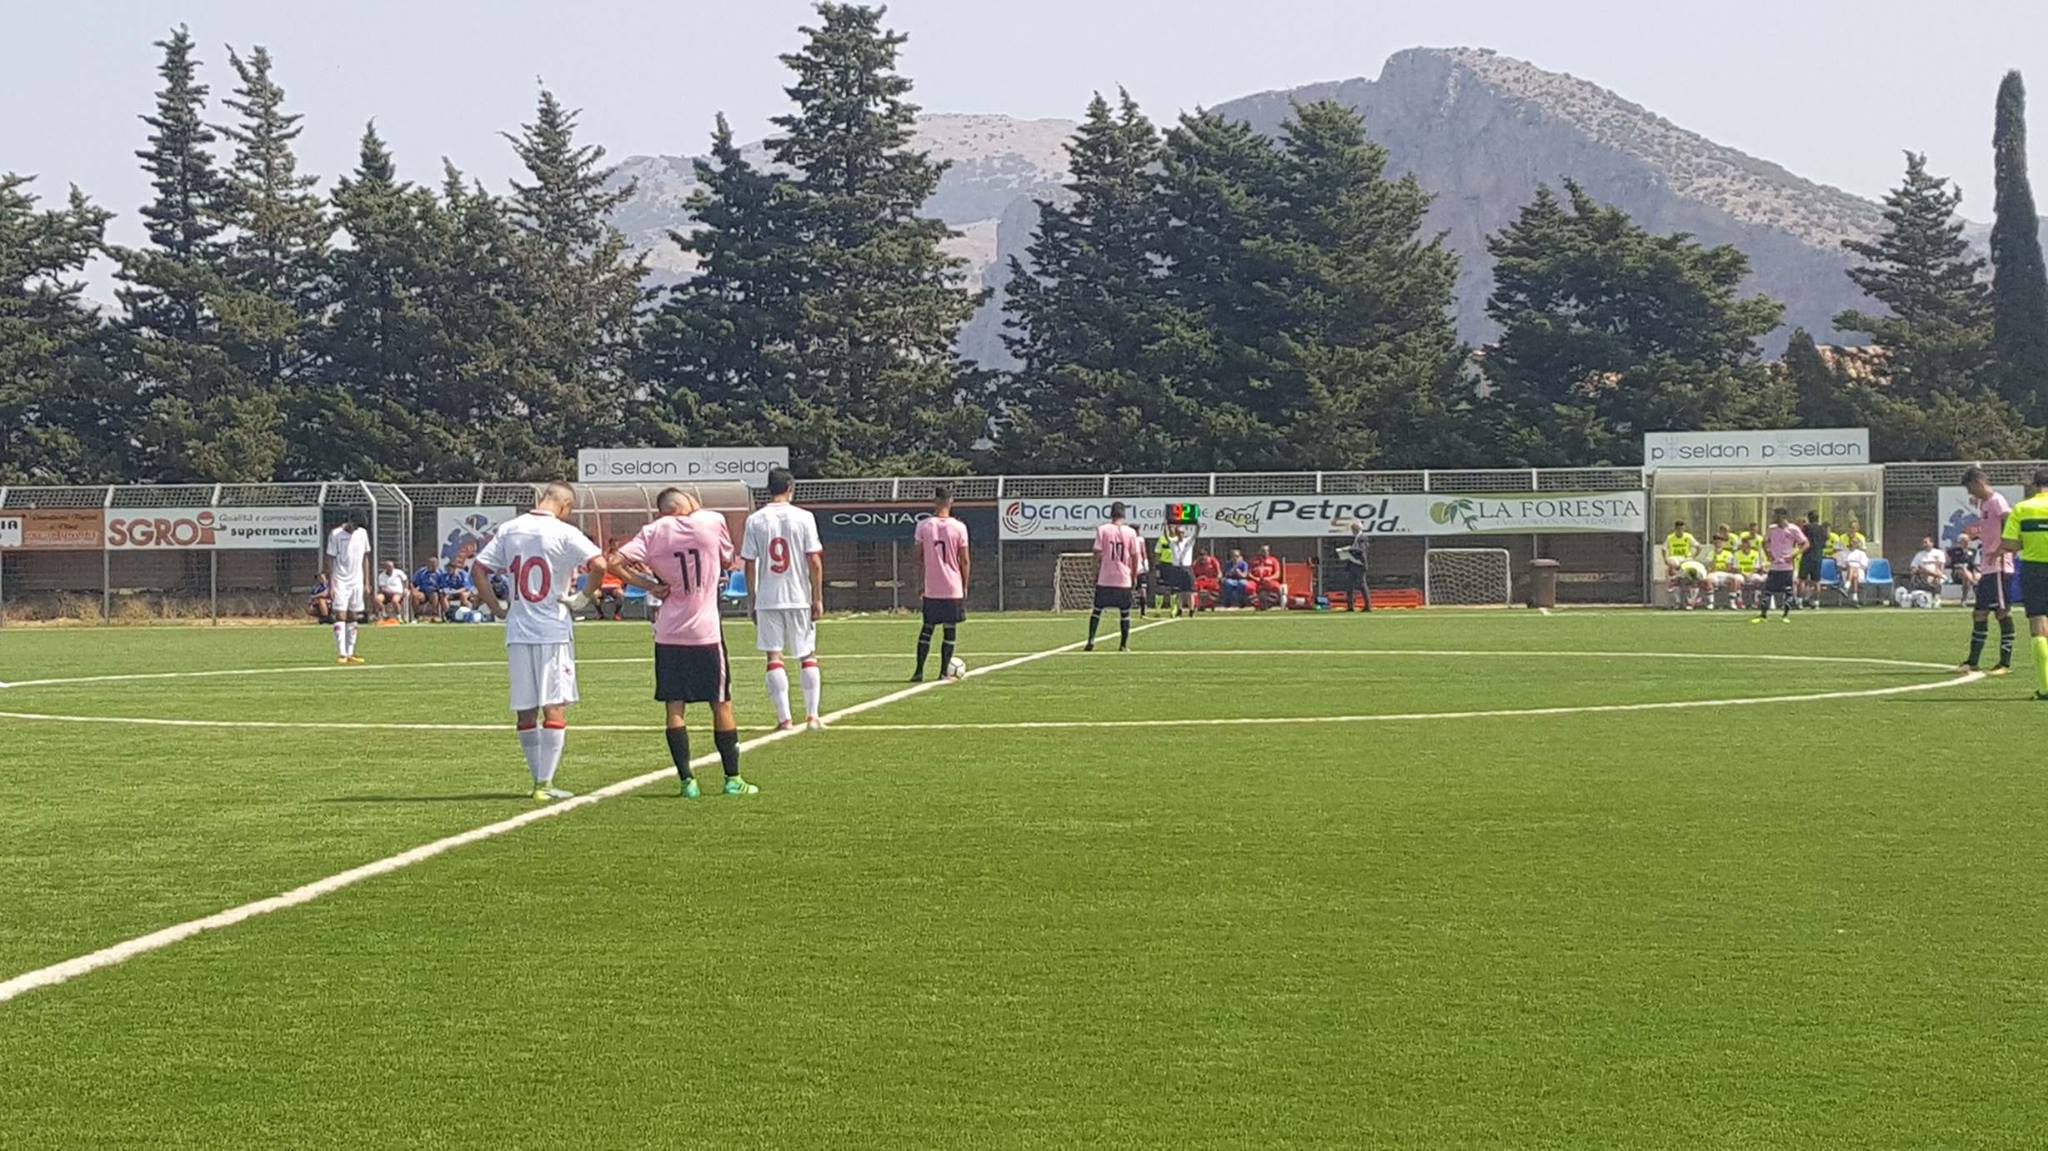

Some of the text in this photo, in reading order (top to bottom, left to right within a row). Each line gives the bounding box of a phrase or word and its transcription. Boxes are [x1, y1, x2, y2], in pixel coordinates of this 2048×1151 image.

[1651, 438, 1860, 461] pseidon pseidon
[585, 457, 677, 476] pseidon
[1266, 499, 1389, 520] Petrol
[1478, 499, 1641, 519] LA FORESTA
[230, 523, 318, 539] supermercati
[769, 536, 790, 574] 9
[509, 555, 551, 603] 10
[673, 549, 702, 595] 11
